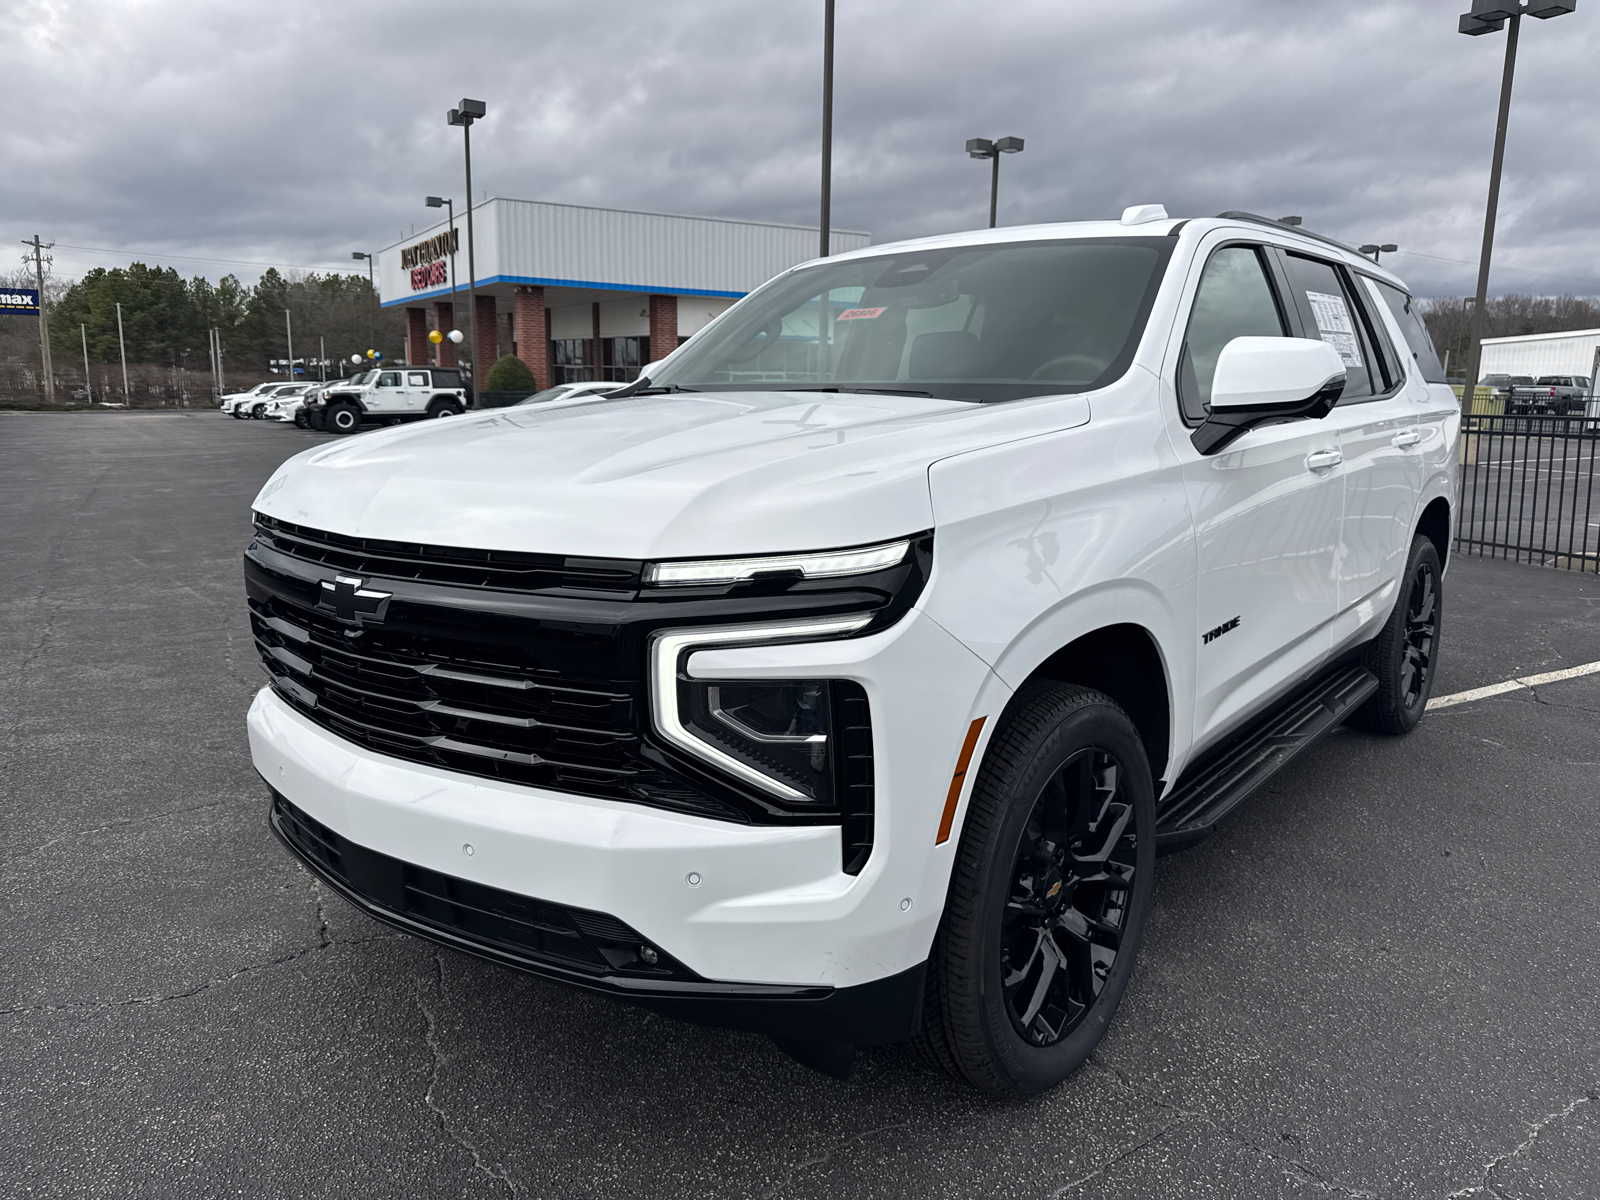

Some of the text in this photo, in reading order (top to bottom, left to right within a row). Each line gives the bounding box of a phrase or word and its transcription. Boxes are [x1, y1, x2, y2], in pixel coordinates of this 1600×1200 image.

[410, 260, 447, 290] USED CARS
[0, 293, 34, 305] max
[1202, 615, 1241, 645] TAHOE
